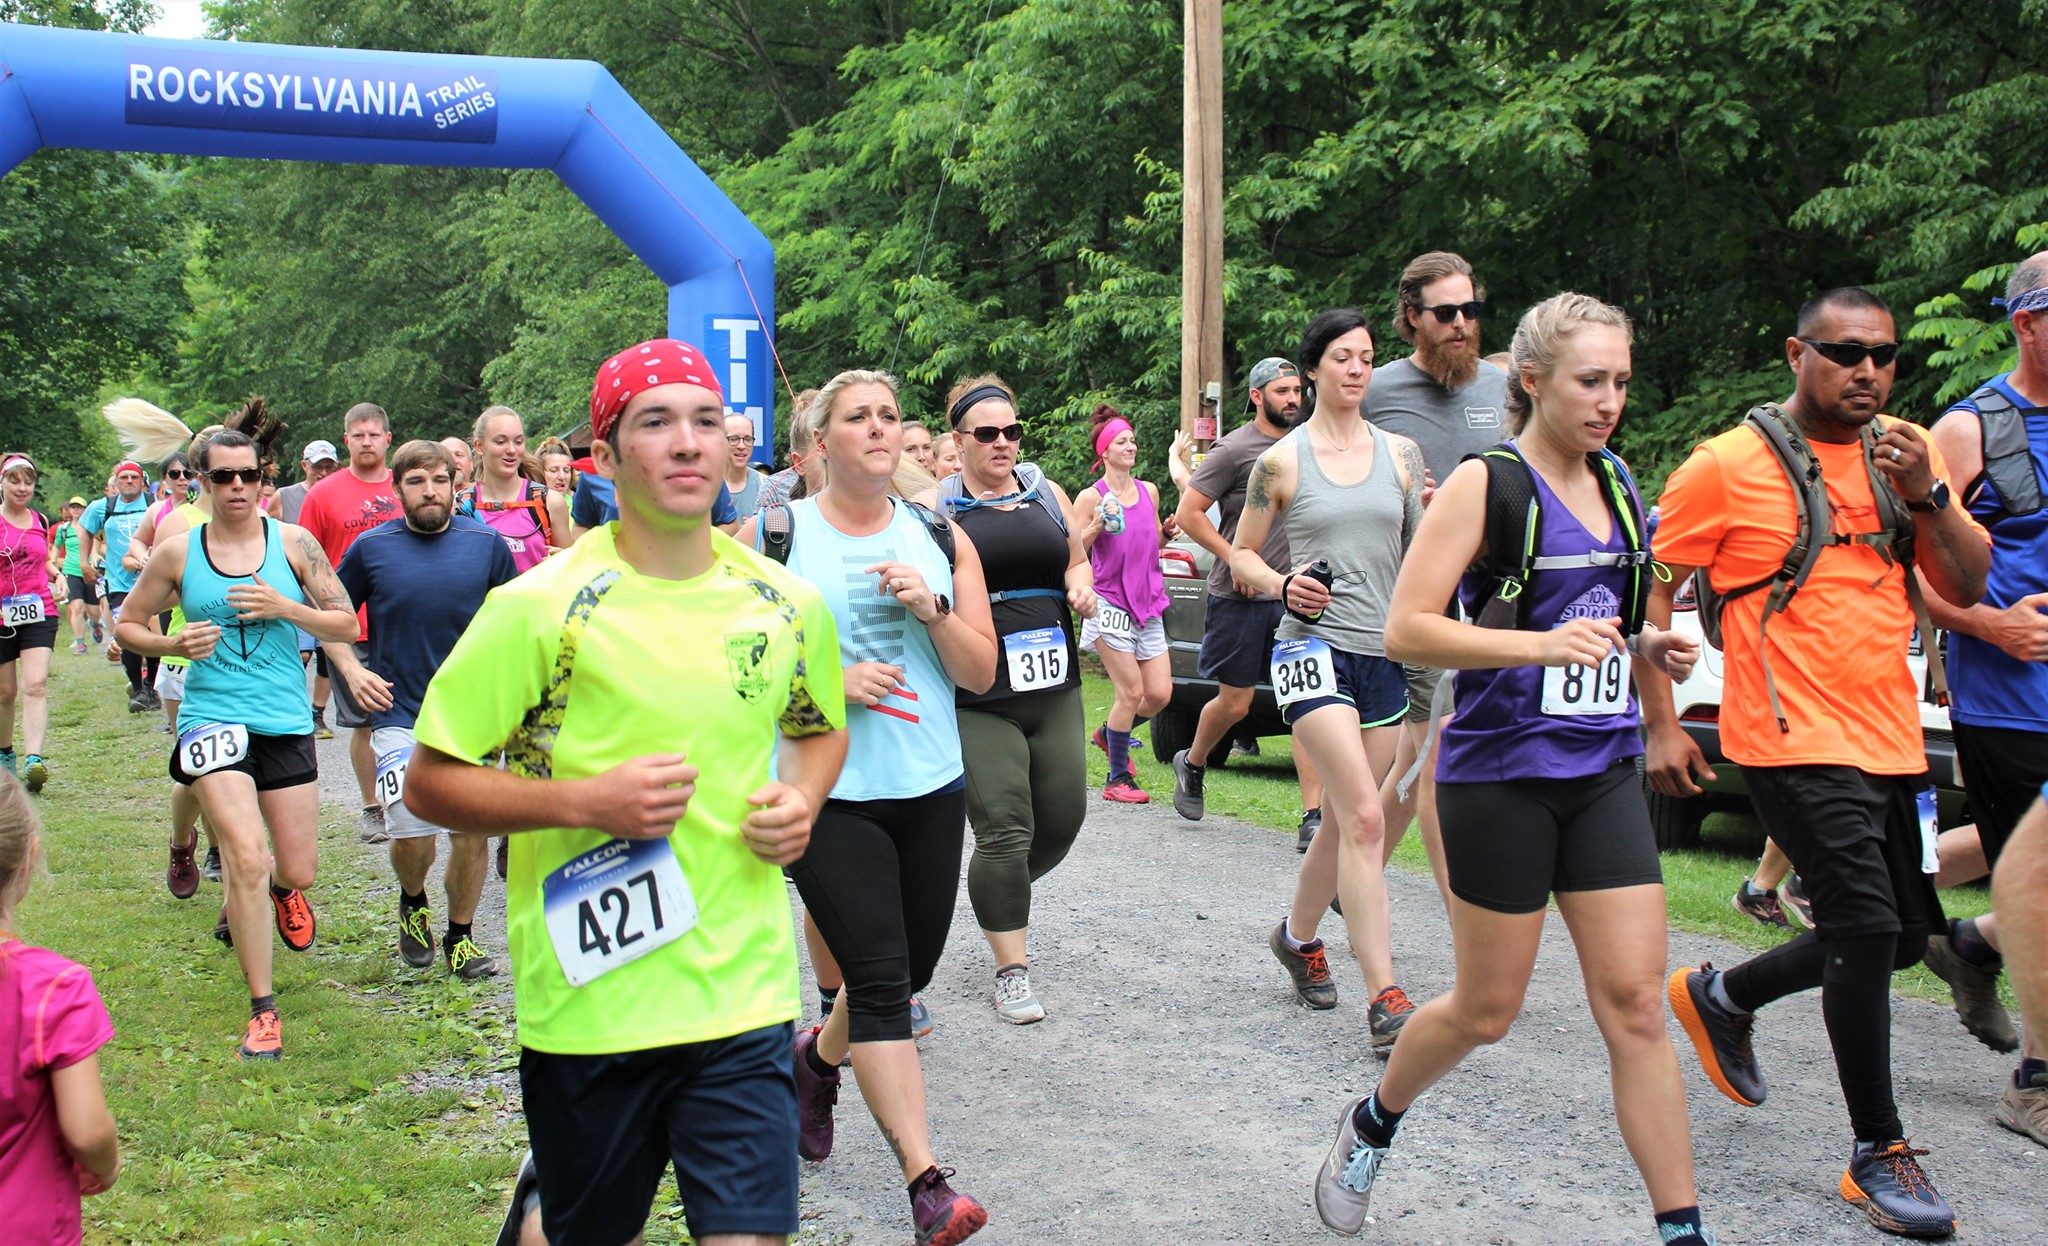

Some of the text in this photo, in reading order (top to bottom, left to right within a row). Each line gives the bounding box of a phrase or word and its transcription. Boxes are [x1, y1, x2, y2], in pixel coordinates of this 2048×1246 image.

[130, 63, 423, 117] ROCKSYLVANIA
[425, 75, 486, 108] TRAIL
[433, 91, 496, 129] SERIES
[344, 519, 388, 529] COWTO
[10, 604, 38, 622] 298
[200, 598, 228, 614] FULL
[1102, 609, 1131, 631] 300
[1021, 630, 1053, 640] FALCON
[214, 655, 263, 673] WELLNESS
[1020, 648, 1060, 683] 315
[1278, 657, 1321, 696] 348
[1562, 655, 1620, 703] 819
[189, 729, 239, 769] 873
[564, 840, 631, 878] FALCON
[579, 869, 664, 957] 427
